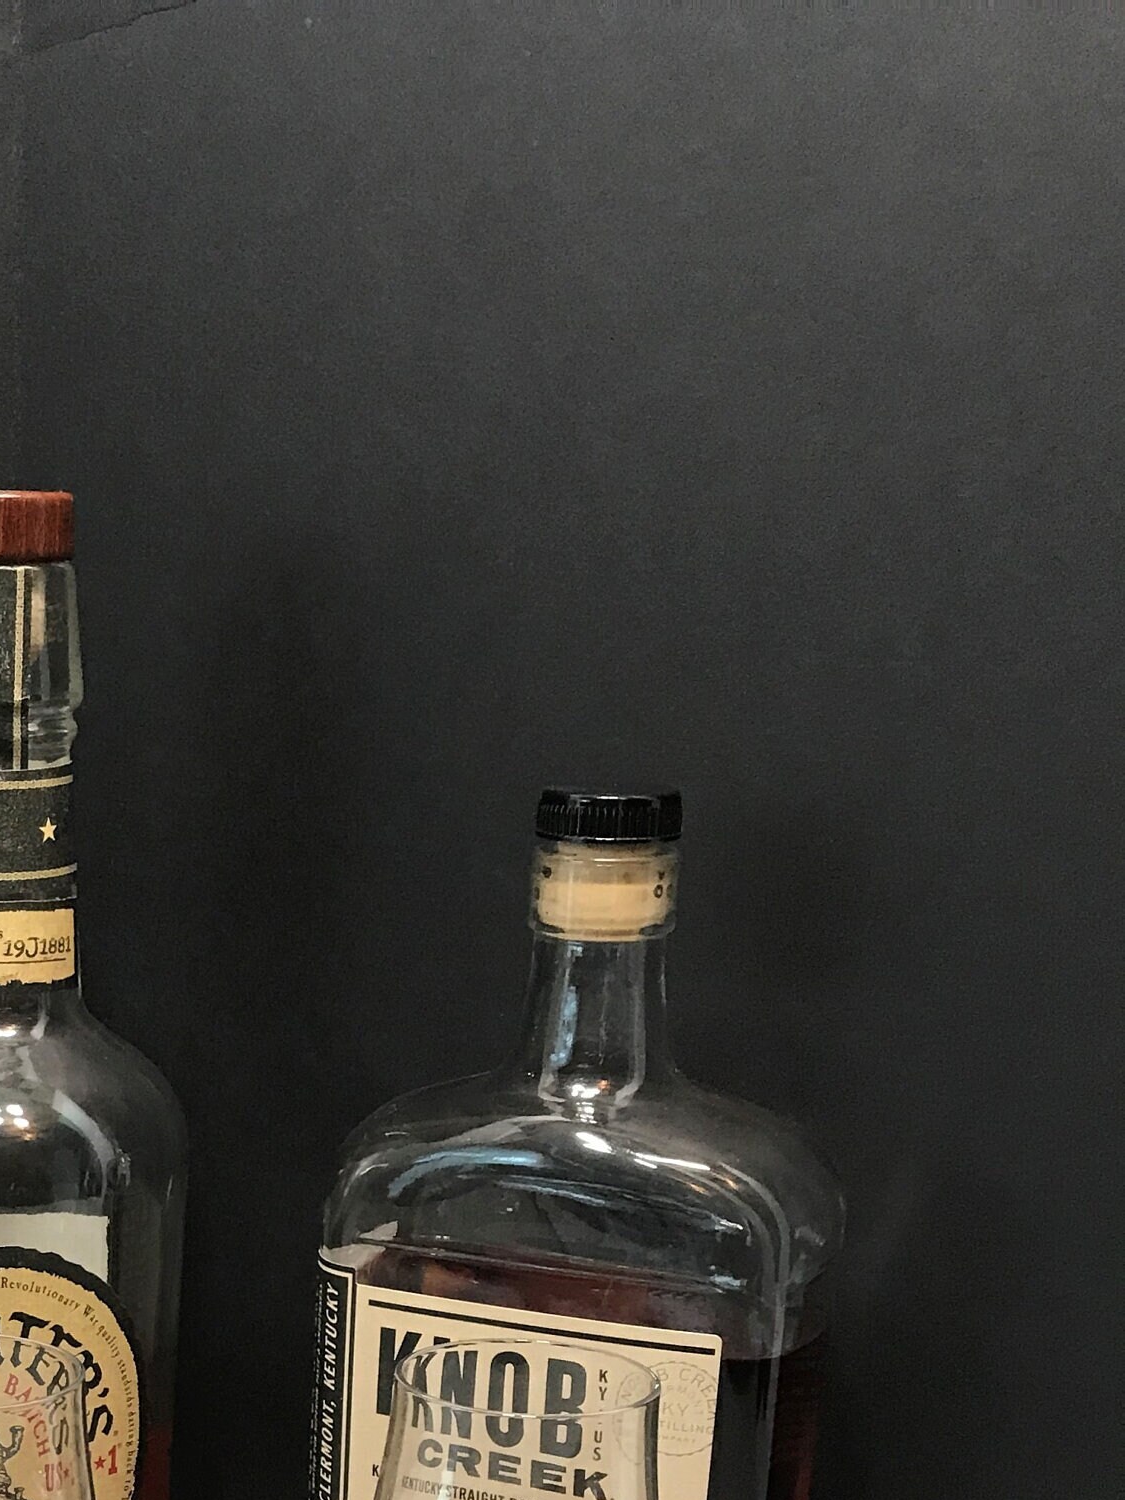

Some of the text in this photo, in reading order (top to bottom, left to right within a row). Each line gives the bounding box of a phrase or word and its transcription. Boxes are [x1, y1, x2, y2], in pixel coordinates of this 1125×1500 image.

[3, 936, 72, 958] 19J1881
[83, 1304, 99, 1326] War
[97, 1325, 120, 1359] quality
[323, 1282, 340, 1391] KENTUCKY
[375, 1327, 587, 1459] KNOB
